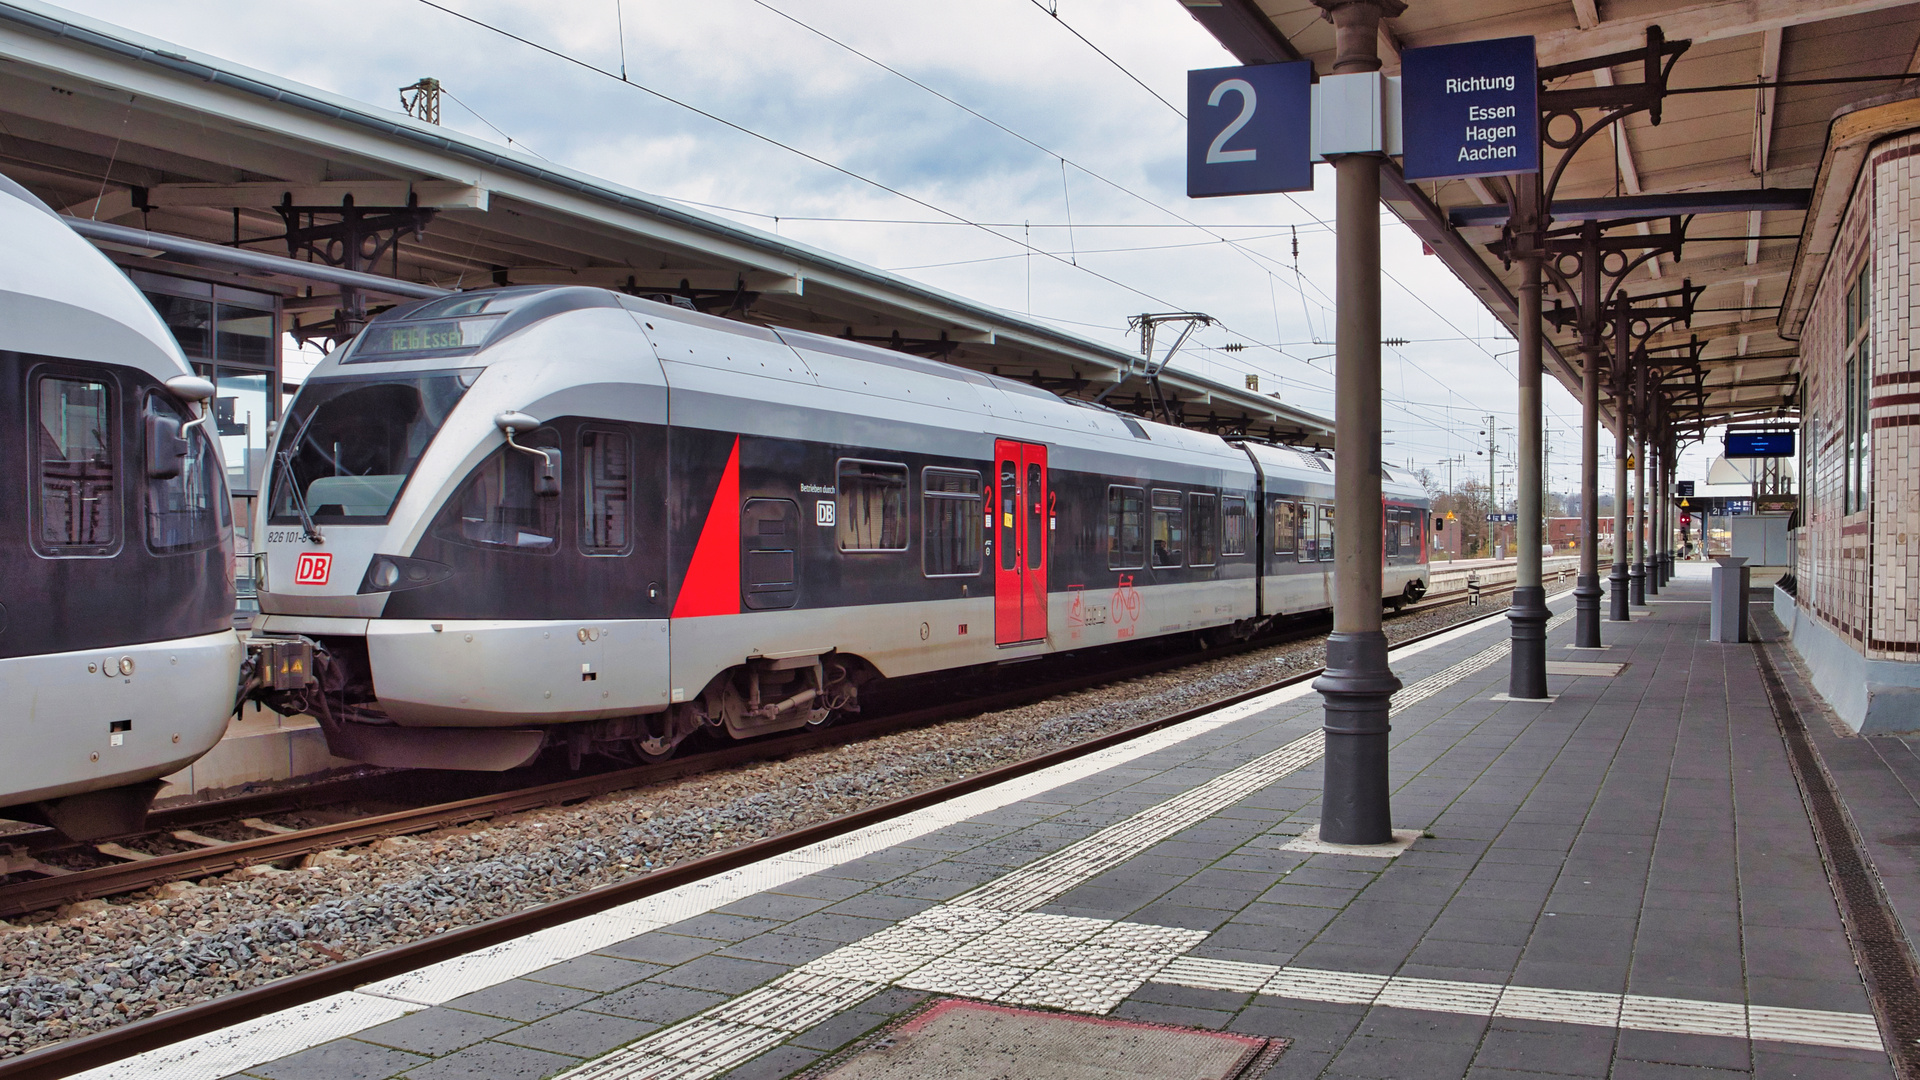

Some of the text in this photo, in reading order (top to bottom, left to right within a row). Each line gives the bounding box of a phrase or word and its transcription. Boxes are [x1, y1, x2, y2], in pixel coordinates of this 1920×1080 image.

[1446, 76, 1515, 94] Richtung
[1206, 78, 1257, 164] 2
[1469, 105, 1516, 121] Essen
[1466, 125, 1516, 142] Hagen
[1457, 144, 1517, 162] Aachen
[800, 483, 836, 494] Betrieben durch
[984, 485, 992, 513] 2
[1049, 491, 1057, 516] 2
[818, 503, 834, 523] DB
[1712, 507, 1718, 515] 2
[267, 531, 308, 543] 826 101-8
[298, 556, 328, 581] DB
